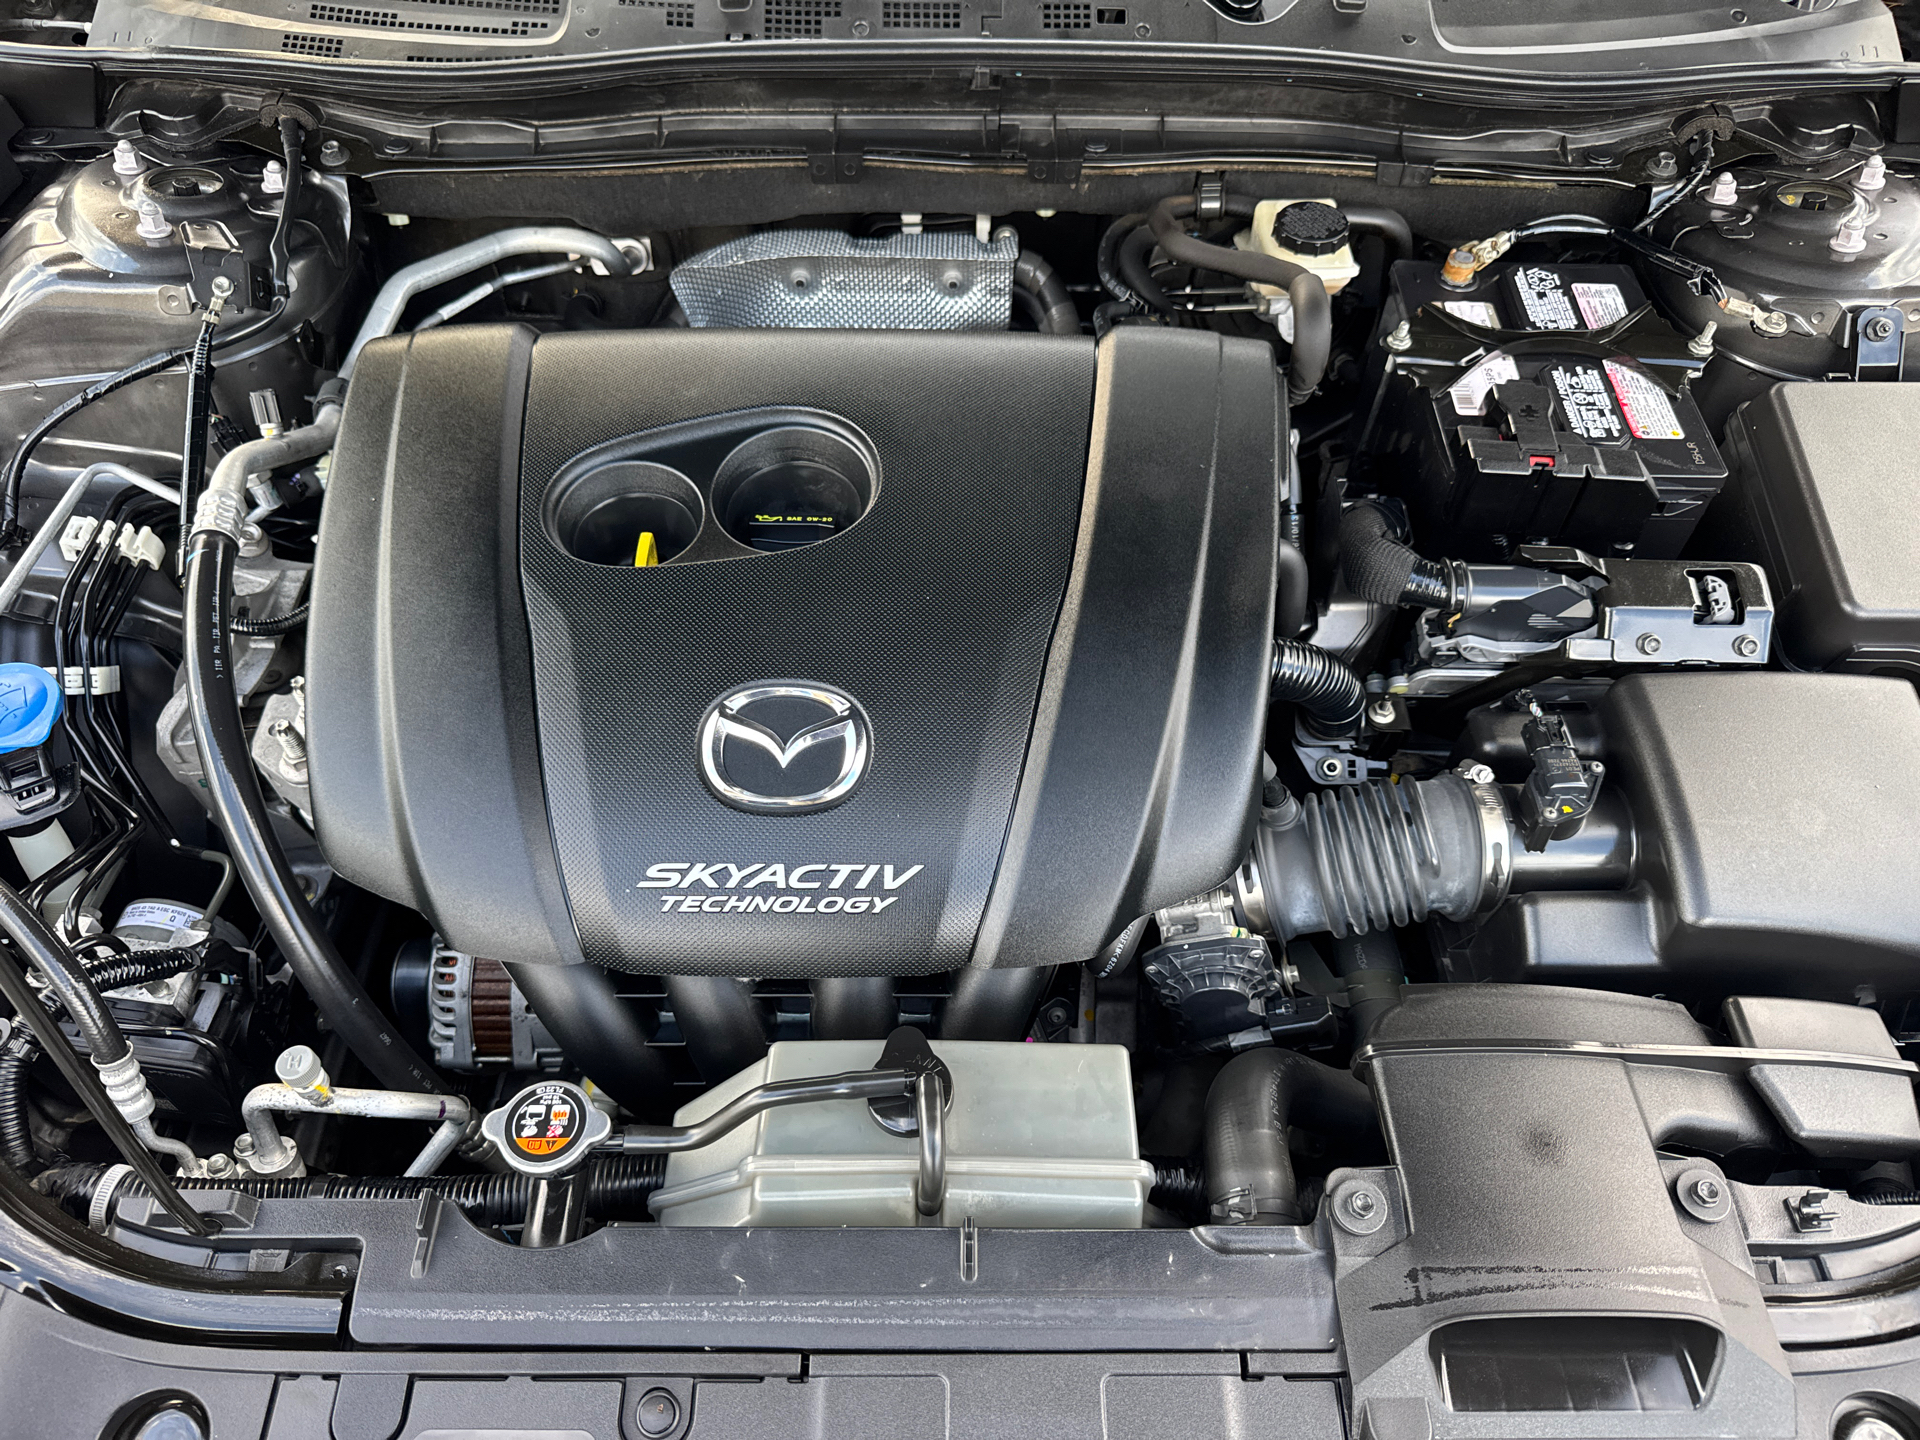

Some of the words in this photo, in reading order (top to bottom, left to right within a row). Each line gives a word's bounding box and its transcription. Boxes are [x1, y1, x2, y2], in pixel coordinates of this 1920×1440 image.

[1551, 370, 1568, 395] POISON
[1562, 400, 1580, 428] DANGER
[636, 863, 925, 890] SKYACTIV
[660, 895, 900, 914] TECHNOLOGY
[287, 1054, 303, 1070] H
